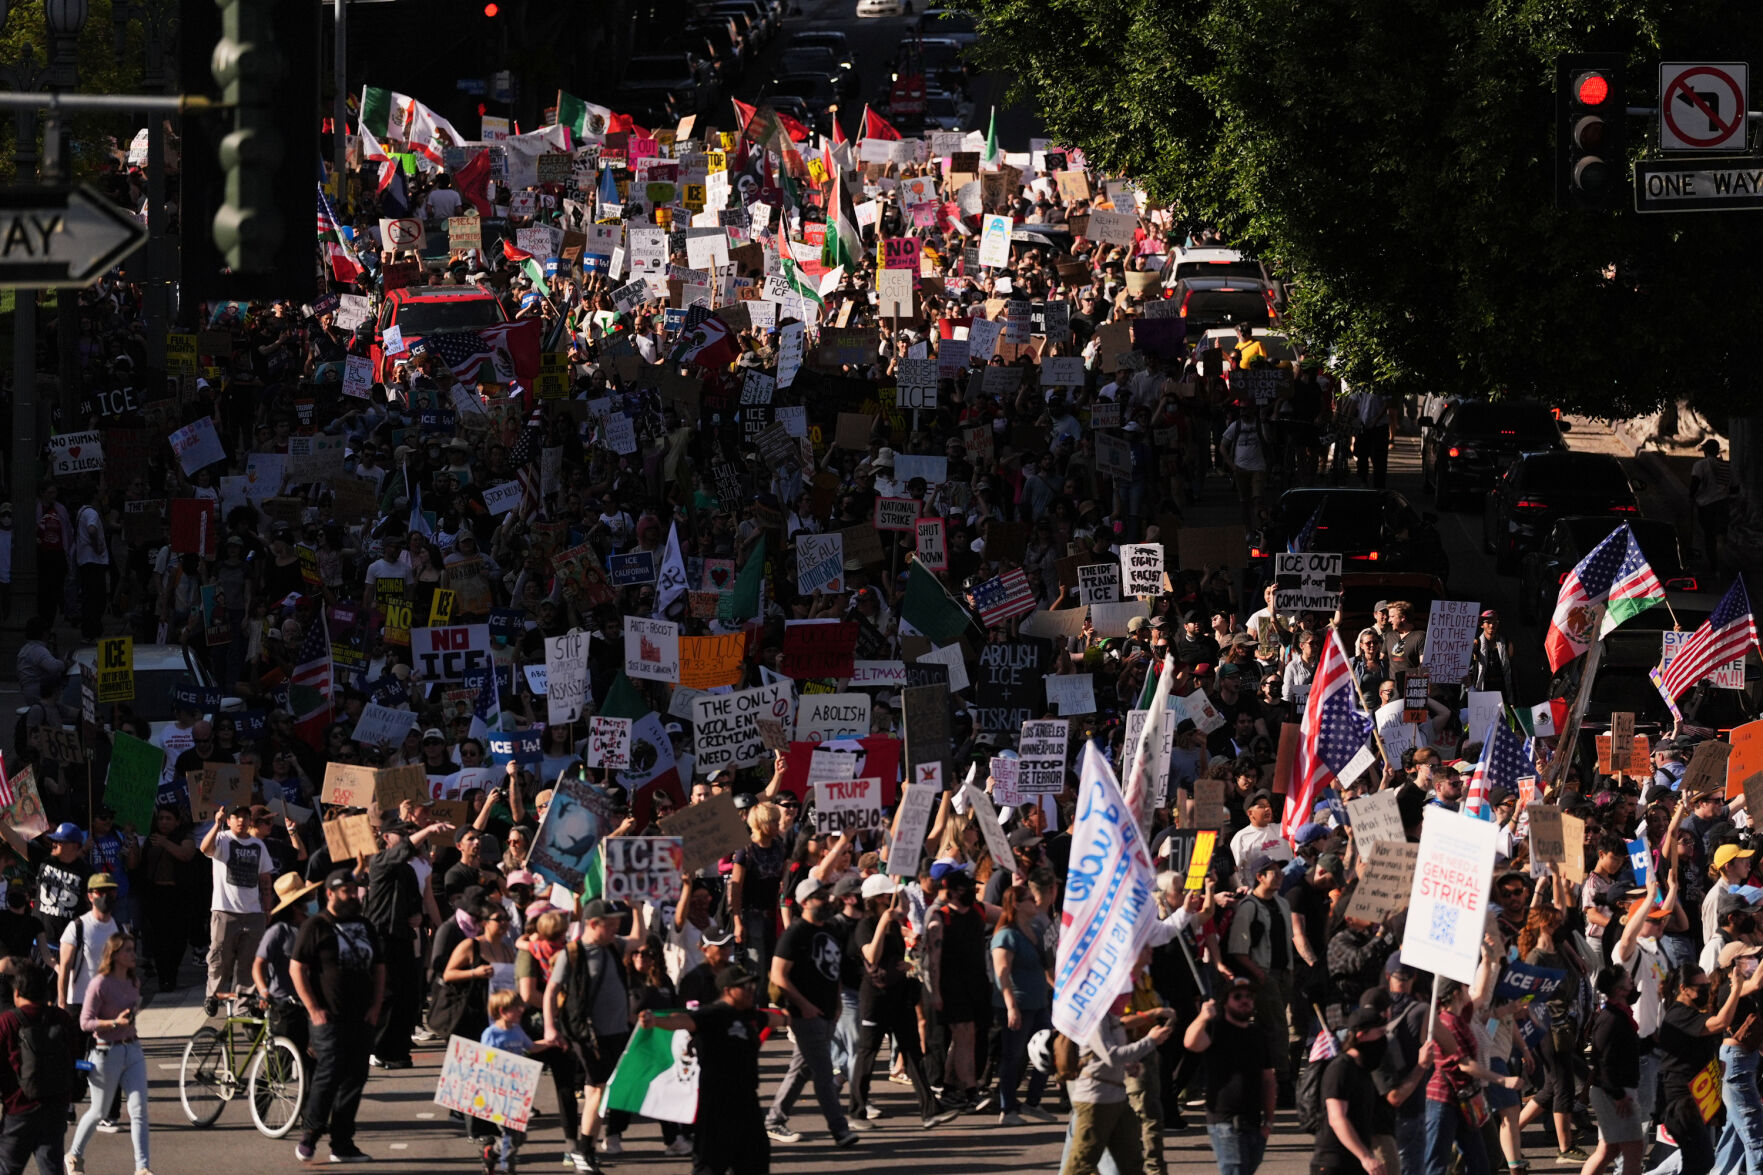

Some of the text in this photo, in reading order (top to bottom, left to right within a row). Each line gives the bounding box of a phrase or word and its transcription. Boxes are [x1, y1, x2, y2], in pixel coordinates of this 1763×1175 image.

[1648, 172, 1763, 196] ONE WAY
[568, 191, 586, 201] ICE
[688, 187, 702, 201] ICE
[449, 217, 480, 226] MELT
[886, 239, 915, 257] NO
[583, 257, 595, 265] ICE
[613, 280, 648, 302] ABOLISH
[522, 295, 534, 304] ICE
[314, 302, 326, 312] ICE
[666, 314, 681, 323] ICE
[171, 336, 189, 345] FULL
[167, 344, 194, 353] RIGHTS
[411, 345, 426, 356] ICE
[899, 359, 938, 367] ABOLISH
[899, 368, 938, 376] ABOLISH
[1055, 371, 1076, 382] ICE
[1248, 370, 1285, 380] JUSTICE
[899, 376, 938, 385] ABOLISH
[898, 385, 936, 408] ICE
[1248, 389, 1278, 399] PEACE
[97, 386, 138, 416] ICE
[746, 408, 766, 420] ICE
[1093, 405, 1104, 413] NO
[421, 415, 437, 424] ICE
[744, 421, 768, 432] OUT
[51, 433, 100, 447] NO HUMAN
[58, 455, 103, 471] IS ILLEGAL
[485, 490, 503, 506] STOP
[880, 500, 916, 513] NATIONAL
[881, 513, 911, 526] STRIKE
[918, 525, 939, 536] SHUT
[796, 536, 818, 557] WE
[925, 538, 933, 550] IT
[624, 555, 638, 565] ICE
[798, 538, 840, 572] ARE ALL
[920, 551, 943, 563] DOWN
[1130, 556, 1159, 568] FIGHT
[1280, 554, 1341, 573] ICE OUT
[613, 565, 651, 579] CALIFORNIA
[1079, 565, 1112, 577] THE IDF
[1130, 570, 1162, 584] FACIST
[1082, 574, 1117, 587] TRAINS
[1311, 578, 1325, 587] our
[1088, 587, 1112, 600] ICE
[1130, 582, 1161, 595] POWER
[436, 590, 452, 616] ICE
[1276, 593, 1340, 609] COMMUNITY!
[385, 604, 413, 630] NO
[489, 615, 507, 627] ICE
[1431, 613, 1477, 628] EMPLOYEE
[430, 628, 469, 651] NO
[1431, 628, 1467, 640] OF THE
[555, 637, 582, 660] STOP
[1432, 640, 1470, 652] MONTH
[104, 640, 126, 669] ICE
[979, 643, 1039, 669] ABOLISH
[1430, 653, 1461, 665] AT THE
[420, 650, 485, 681] ICE
[101, 672, 113, 683] OUT
[464, 676, 484, 688] ICE
[988, 667, 1023, 685] ICE
[176, 690, 222, 706] ICE LA!
[700, 686, 779, 719] THE ONLY
[1406, 699, 1426, 708] TRUMP
[811, 705, 866, 722] ABOLISH
[696, 710, 760, 735] VIOLENT
[697, 728, 761, 748] CRIMINA
[1022, 726, 1066, 738] LOS ANGELES
[1391, 731, 1402, 739] LA
[490, 738, 541, 753] ICE LA!
[1021, 743, 1064, 755] MINNEAPOLIS
[698, 749, 731, 766] NEED
[1019, 760, 1063, 770] STOP
[1019, 770, 1062, 785] ICE TERROR
[825, 781, 870, 801] TRUMP
[818, 808, 881, 832] PENDEJO
[607, 839, 674, 871] ICE
[1430, 851, 1445, 862] WE
[1446, 855, 1469, 870] NEED
[1630, 852, 1649, 870] ICE
[1423, 861, 1481, 893] GENERAL
[39, 882, 80, 908] UP
[1419, 877, 1479, 912] STRIKE
[1503, 969, 1561, 993] ICE LA!
